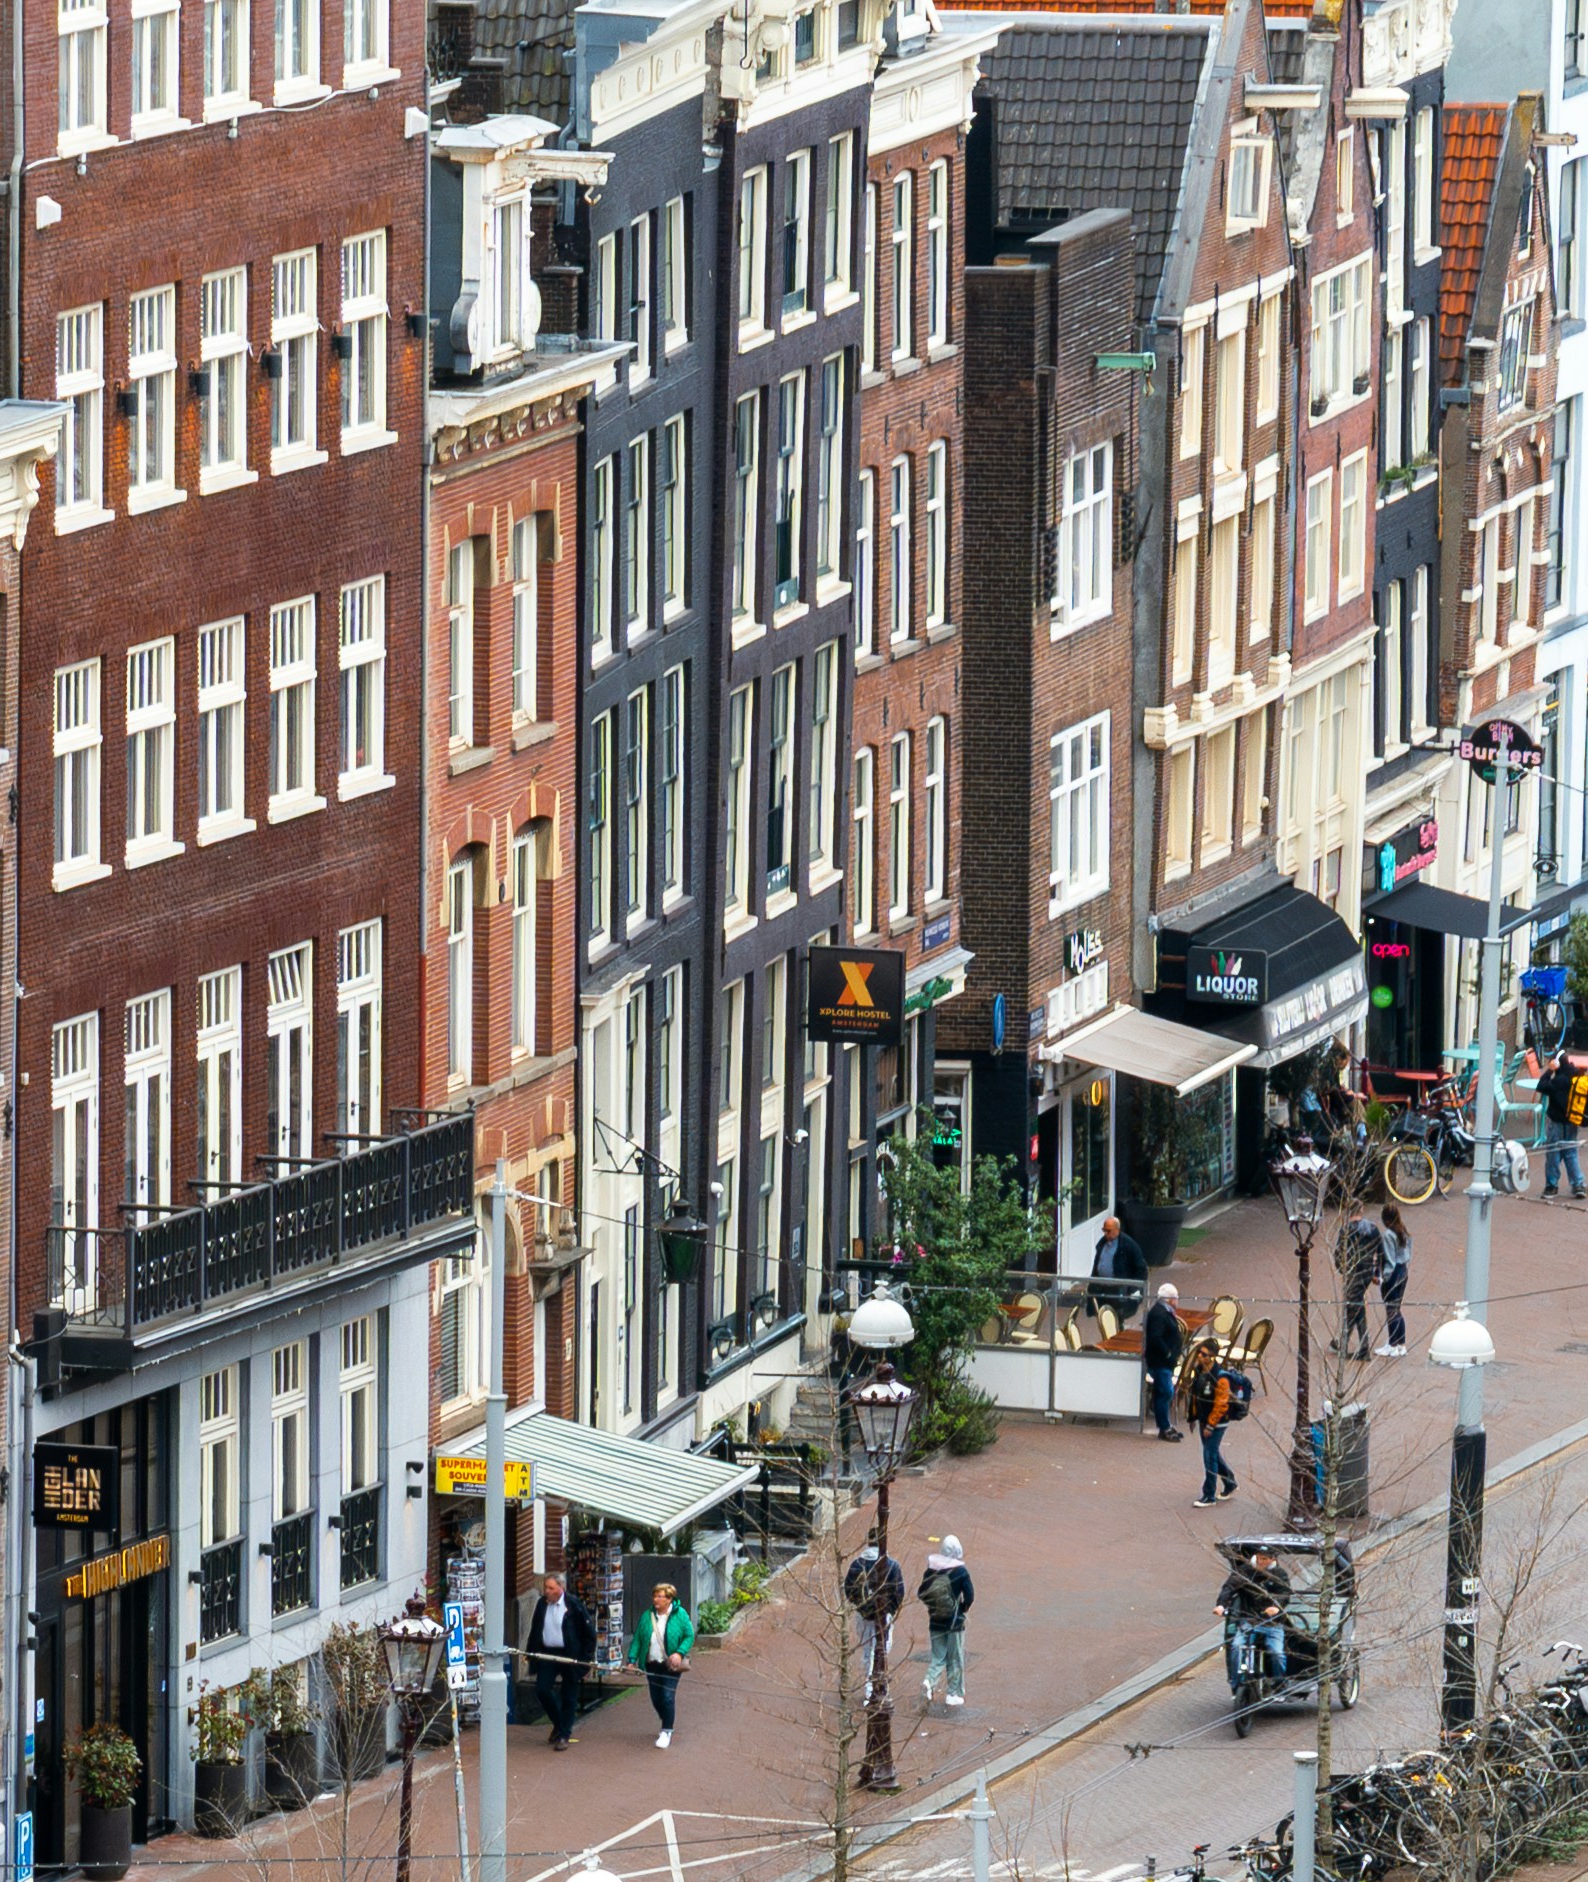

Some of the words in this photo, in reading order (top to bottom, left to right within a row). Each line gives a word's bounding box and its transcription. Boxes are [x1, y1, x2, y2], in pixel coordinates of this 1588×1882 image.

[1461, 741, 1542, 765] Burers
[1373, 943, 1410, 958] open
[1196, 974, 1258, 995] LIQUOR
[1223, 992, 1258, 1001] STORE
[819, 1007, 855, 1017] XPLORE
[856, 1009, 891, 1020] HOSTEL
[68, 1454, 78, 1462] THE
[440, 1459, 515, 1472] SUPERMAET
[62, 1467, 101, 1489] LAN
[519, 1464, 528, 1497] ATM
[62, 1488, 101, 1511] DER
[56, 1513, 89, 1523] AMSTERDAM
[82, 1534, 170, 1599] HIGHLANDER
[20, 1821, 30, 1855] P
